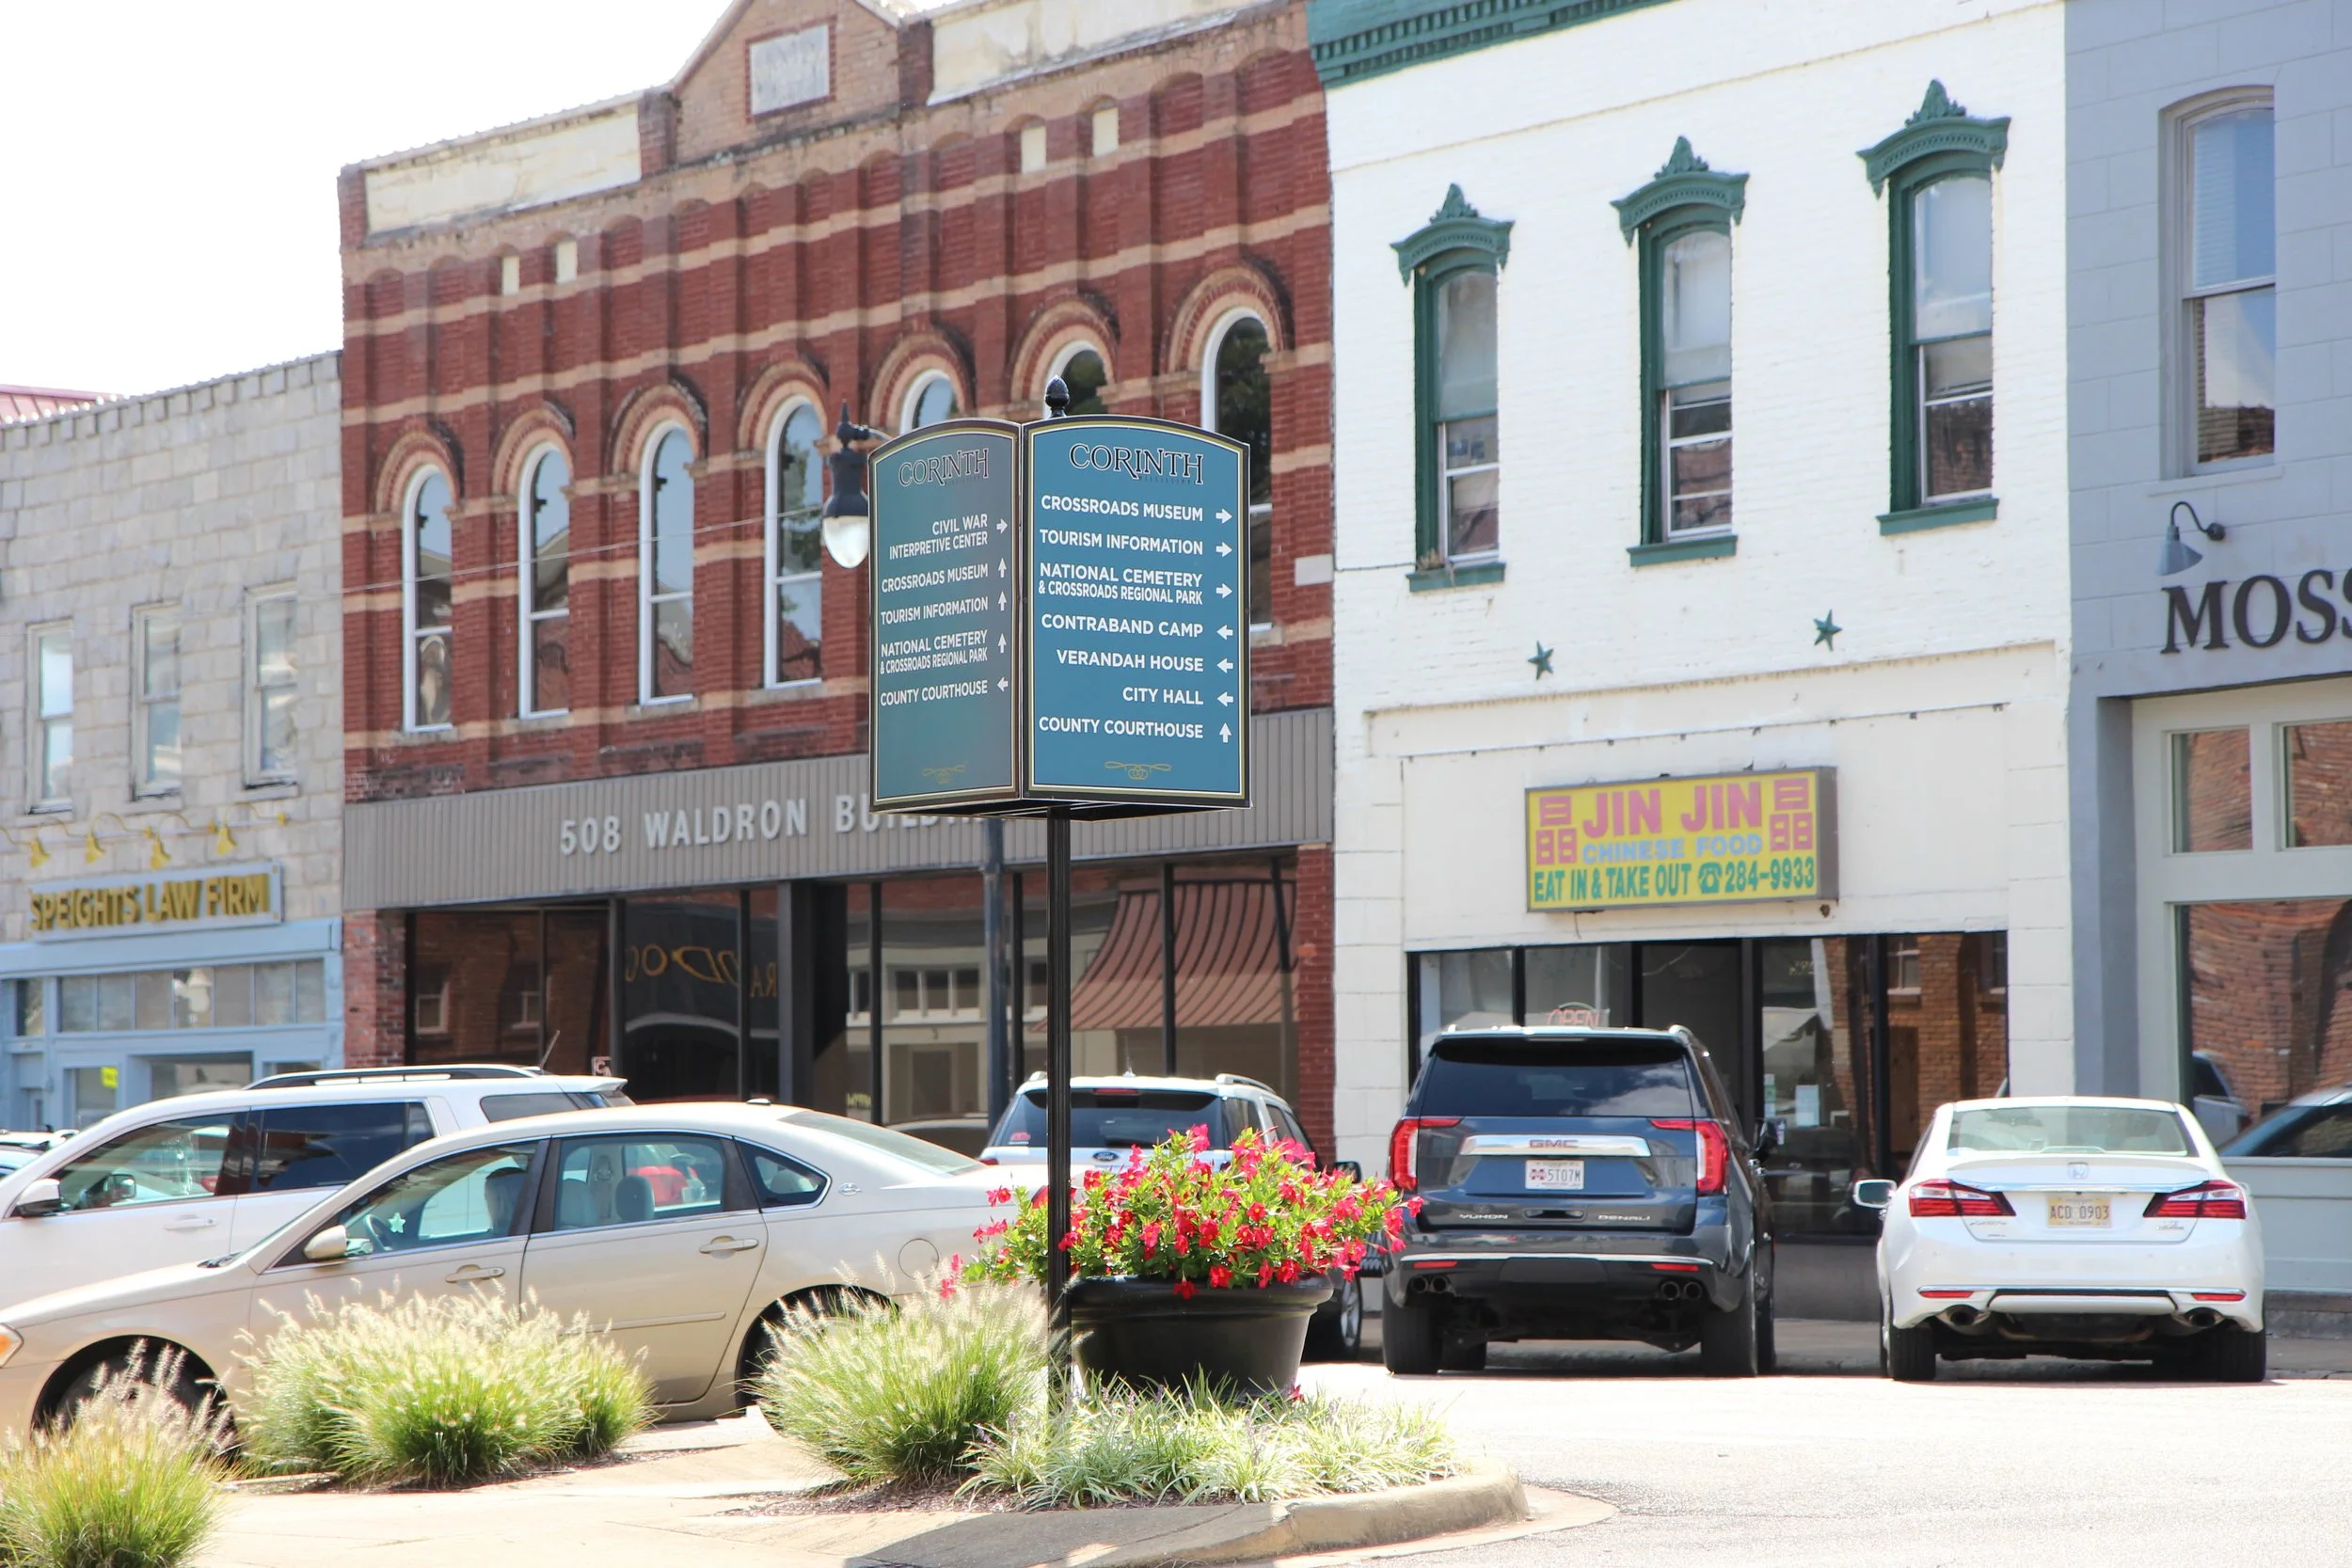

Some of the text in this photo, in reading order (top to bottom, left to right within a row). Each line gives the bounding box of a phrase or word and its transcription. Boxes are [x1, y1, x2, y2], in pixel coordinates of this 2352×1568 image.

[898, 448, 989, 487] CORINTH
[1070, 443, 1203, 485] CORINTH
[1041, 495, 1203, 521] CROSSROADS MUSEUM
[932, 514, 988, 535] CIVIL WAR
[889, 531, 988, 560] INTERPRETIVE CENTER
[1040, 529, 1203, 555] TOURISM INFORMATION
[882, 563, 989, 593] CROSSROADS MUSEUM
[1040, 562, 1203, 588] NATIONAL CEMETERY
[1039, 580, 1203, 605] & CROSSROADS REGIONAL PARK
[881, 596, 989, 625] TOURISM INFORMATION
[2160, 568, 2352, 655] MOS
[1041, 613, 1203, 637] CONTRABAND CAMP
[881, 629, 988, 657] NATIONAL CEMETERY
[880, 647, 988, 674] & CROSSROADS REGIONAL PARK
[1057, 649, 1203, 672] VERANDAH HOUSE
[881, 680, 988, 706] COUNTY COURTHOUSE
[1122, 687, 1203, 705] CITY HALL
[1039, 717, 1203, 738] COUNTY COURTHOUSE
[1583, 782, 1762, 838] JIN JIN
[560, 816, 622, 855] 508
[644, 798, 808, 847] WALDRON
[1582, 833, 1763, 863] CHINESE FOOD
[1534, 857, 1815, 902] EAT IN & TAKE OUT 284-9933
[30, 873, 271, 930] SPEIGHTS LAW FIRM
[1529, 1139, 1578, 1148] GMC
